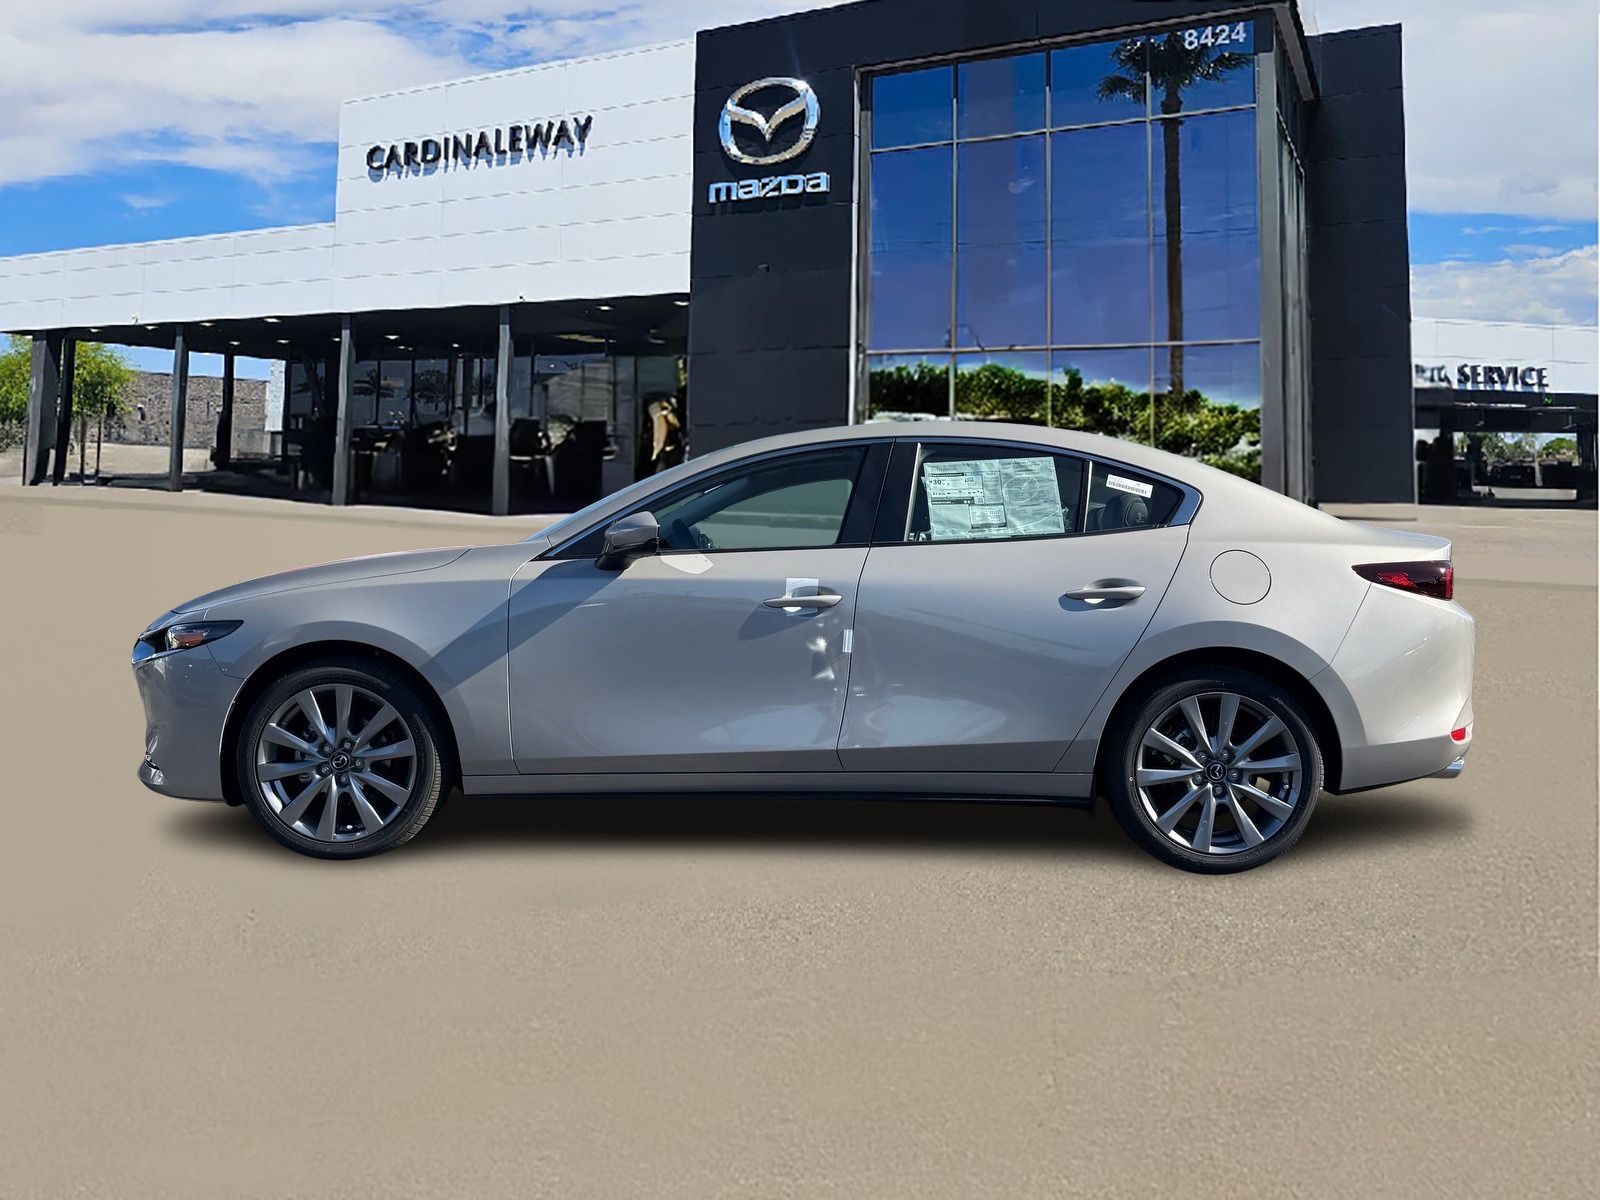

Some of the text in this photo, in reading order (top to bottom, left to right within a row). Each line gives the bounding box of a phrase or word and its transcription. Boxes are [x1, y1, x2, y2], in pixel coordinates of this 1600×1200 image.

[1184, 22, 1246, 50] 8424
[366, 115, 593, 171] CARDINALEWAY
[1457, 363, 1549, 388] SERVICE
